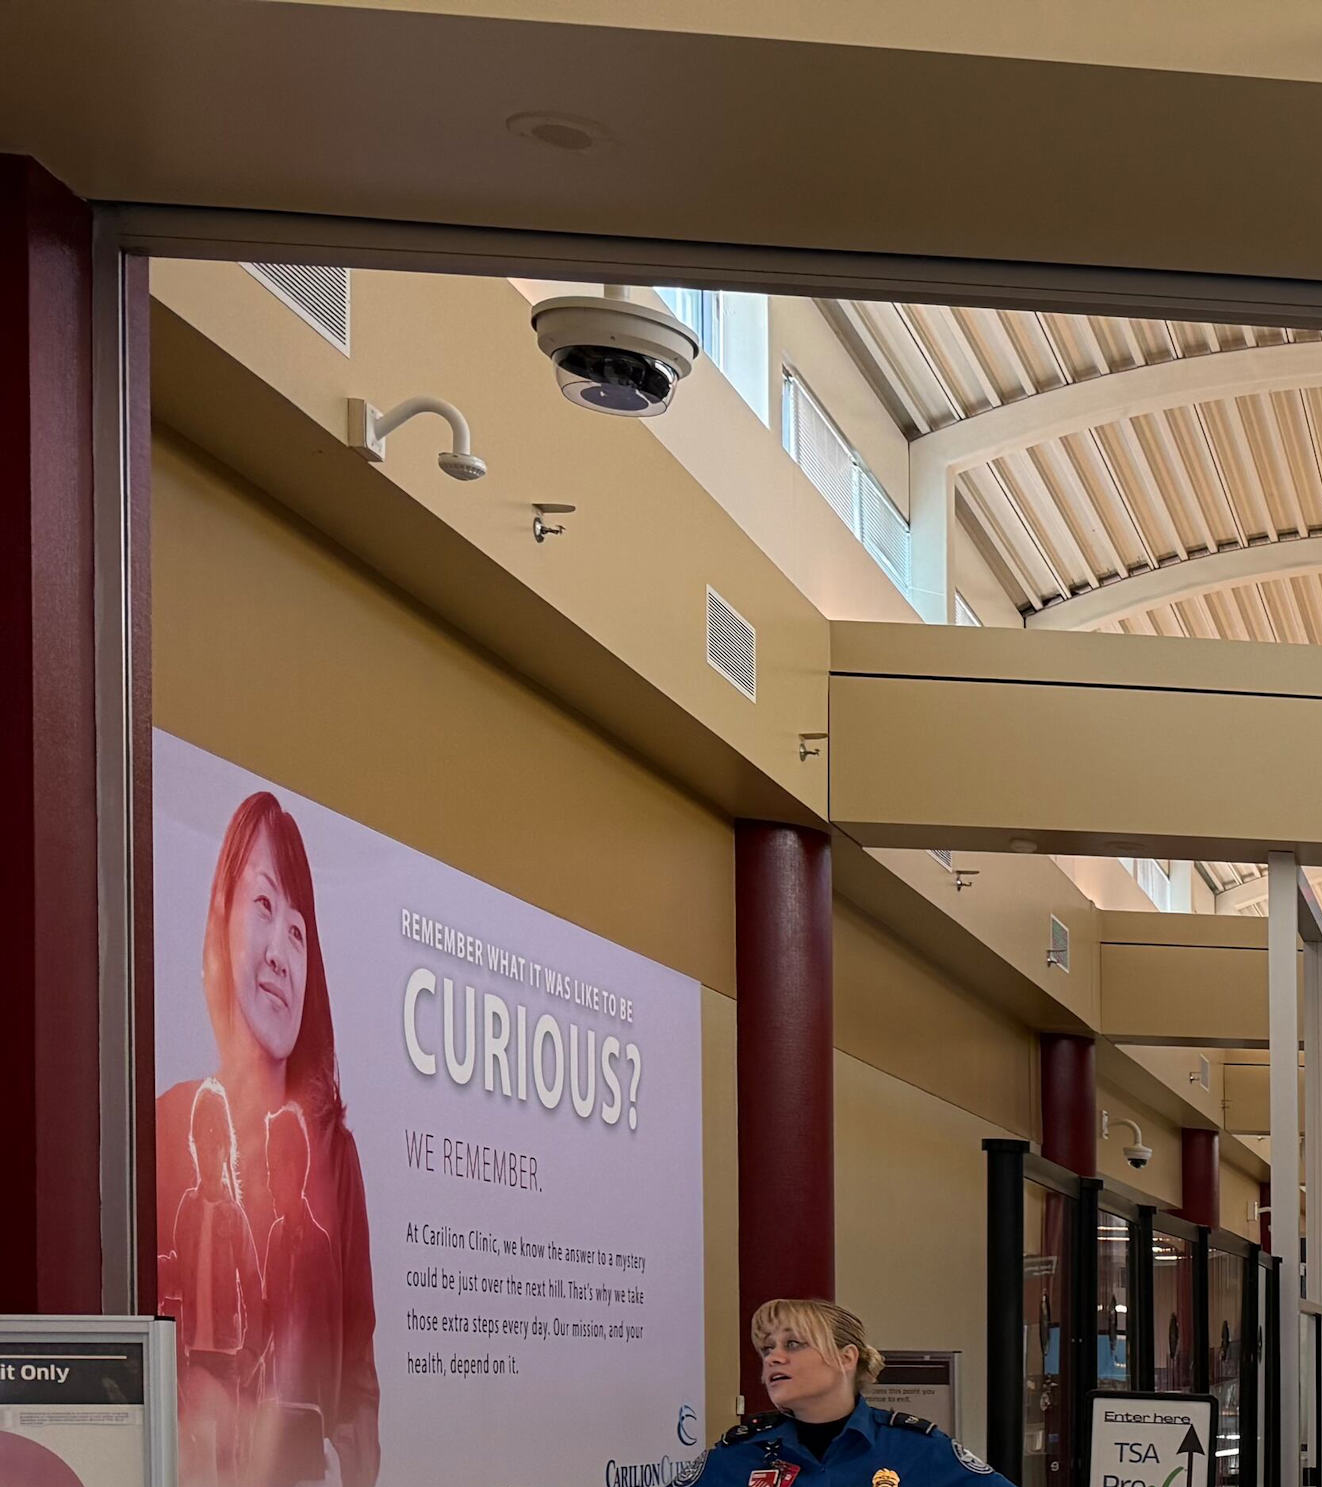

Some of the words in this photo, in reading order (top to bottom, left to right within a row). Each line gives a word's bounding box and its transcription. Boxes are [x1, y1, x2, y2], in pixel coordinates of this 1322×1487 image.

[402, 908, 483, 966] REMEMBER
[487, 943, 526, 982] WHAT
[529, 962, 541, 986] IT
[545, 967, 571, 1000] WAS
[575, 980, 600, 1011] LIKE
[602, 991, 617, 1017] TO
[620, 998, 634, 1022] BE
[403, 967, 641, 1131] CURIOUS?
[405, 1129, 434, 1172] WE
[443, 1137, 543, 1193] REMEMBER.
[406, 1222, 418, 1244] At
[422, 1224, 465, 1250] Carilion
[468, 1230, 500, 1256] Clinic,
[503, 1239, 517, 1255] we
[520, 1237, 545, 1258] know
[548, 1241, 563, 1261] the
[564, 1247, 595, 1264] answer
[597, 1249, 606, 1266] to
[608, 1252, 613, 1266] a
[615, 1252, 646, 1273] mystery
[406, 1267, 438, 1289] could
[441, 1268, 455, 1290] be
[457, 1271, 478, 1296] just
[481, 1276, 504, 1294] over
[506, 1275, 522, 1296] the
[525, 1279, 546, 1298] next
[549, 1279, 566, 1299] hill.
[568, 1281, 593, 1301] That's
[596, 1283, 612, 1306] why
[614, 1289, 626, 1303] we
[627, 1286, 644, 1305] take
[406, 1308, 438, 1331] those
[441, 1313, 469, 1333] extra
[472, 1315, 499, 1338] steps
[502, 1319, 529, 1341] every
[531, 1315, 550, 1341] day.
[552, 1318, 569, 1337] Our
[571, 1320, 606, 1341] mission,
[608, 1320, 623, 1339] and
[625, 1324, 643, 1343] your
[0, 1363, 15, 1380] it
[20, 1363, 70, 1383] Only
[407, 1352, 446, 1377] health,
[450, 1353, 489, 1379] depend
[492, 1358, 505, 1375] on
[508, 1356, 519, 1375] it.
[1104, 1411, 1151, 1423] Enter
[1154, 1413, 1191, 1424] here
[1114, 1442, 1160, 1464] TSA
